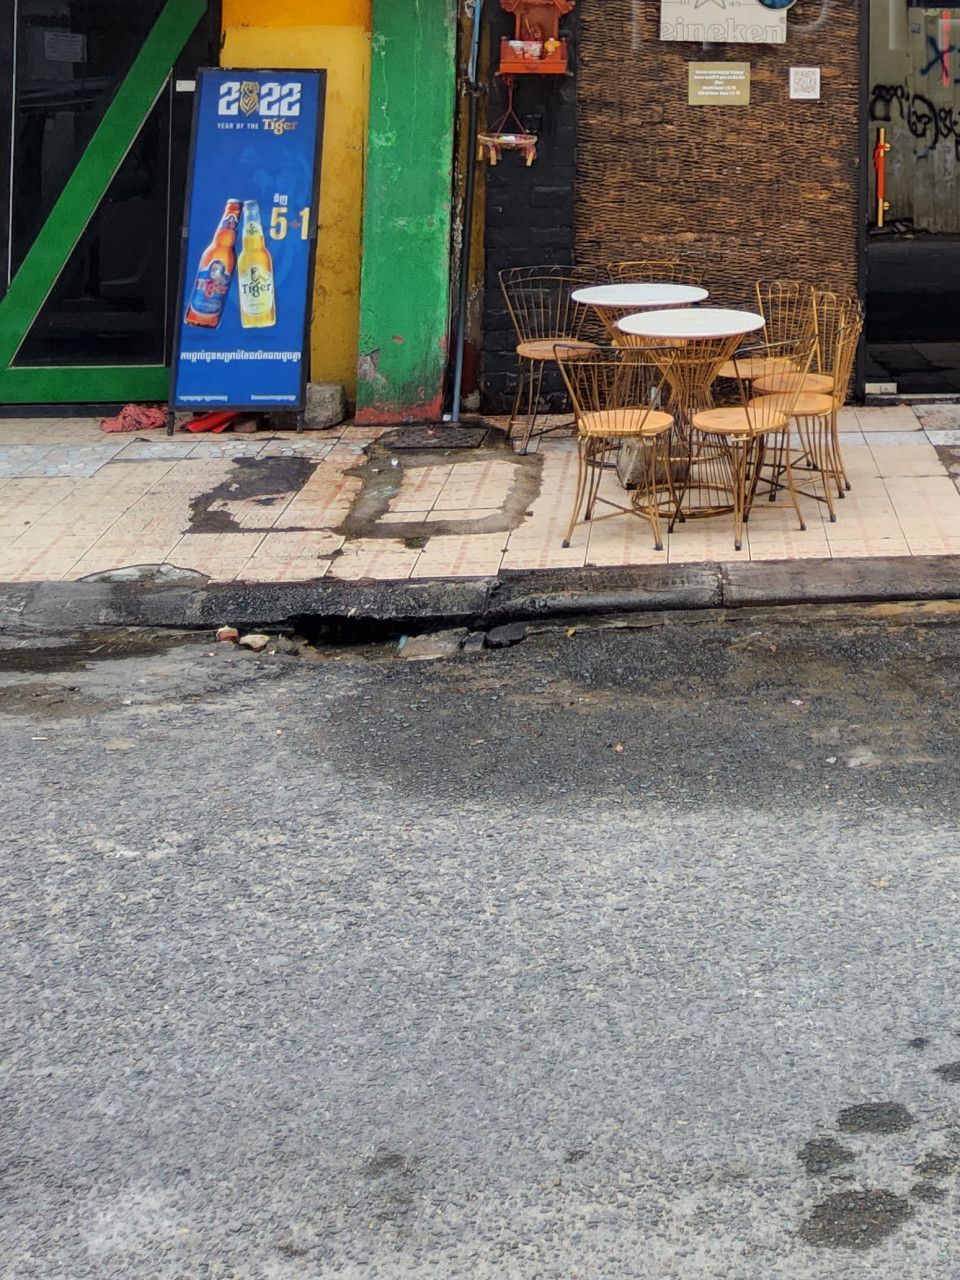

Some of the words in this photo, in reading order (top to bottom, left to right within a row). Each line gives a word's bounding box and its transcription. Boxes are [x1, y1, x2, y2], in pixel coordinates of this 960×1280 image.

[217, 122, 234, 130] YEAR
[236, 122, 244, 130] OF
[247, 122, 259, 130] THE
[262, 117, 298, 135] Tiger
[241, 281, 272, 298] Tiger
